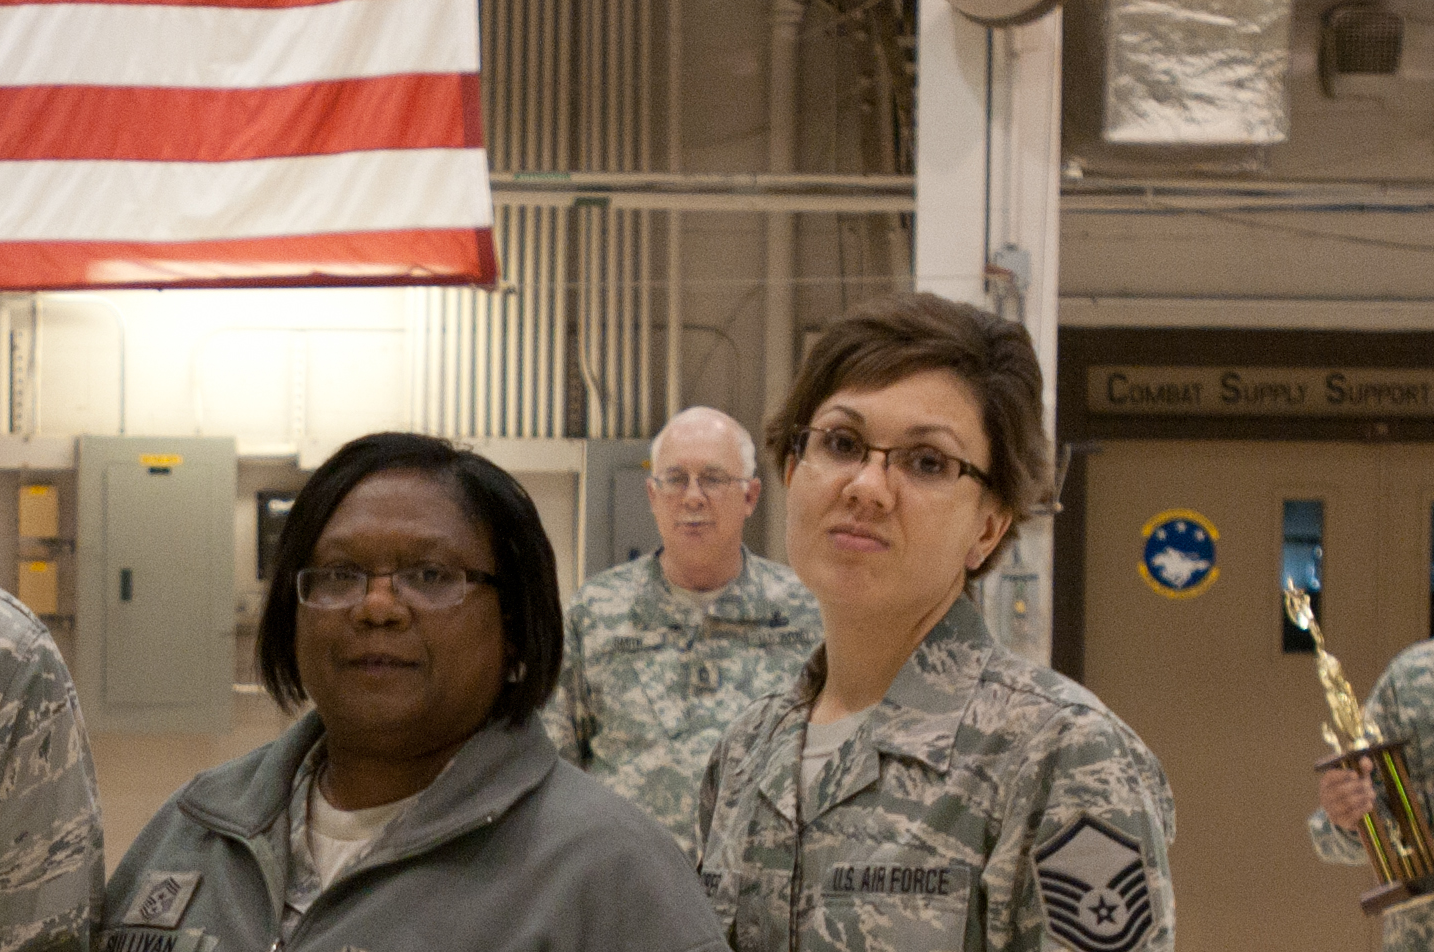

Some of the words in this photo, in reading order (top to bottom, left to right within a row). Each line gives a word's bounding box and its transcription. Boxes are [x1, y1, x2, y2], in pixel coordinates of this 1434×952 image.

[1106, 371, 1204, 405] COMBAT
[1220, 371, 1308, 404] SUPPLY
[1326, 372, 1430, 404] SUPPORT
[861, 865, 886, 893] AIR
[889, 866, 950, 895] FORCE
